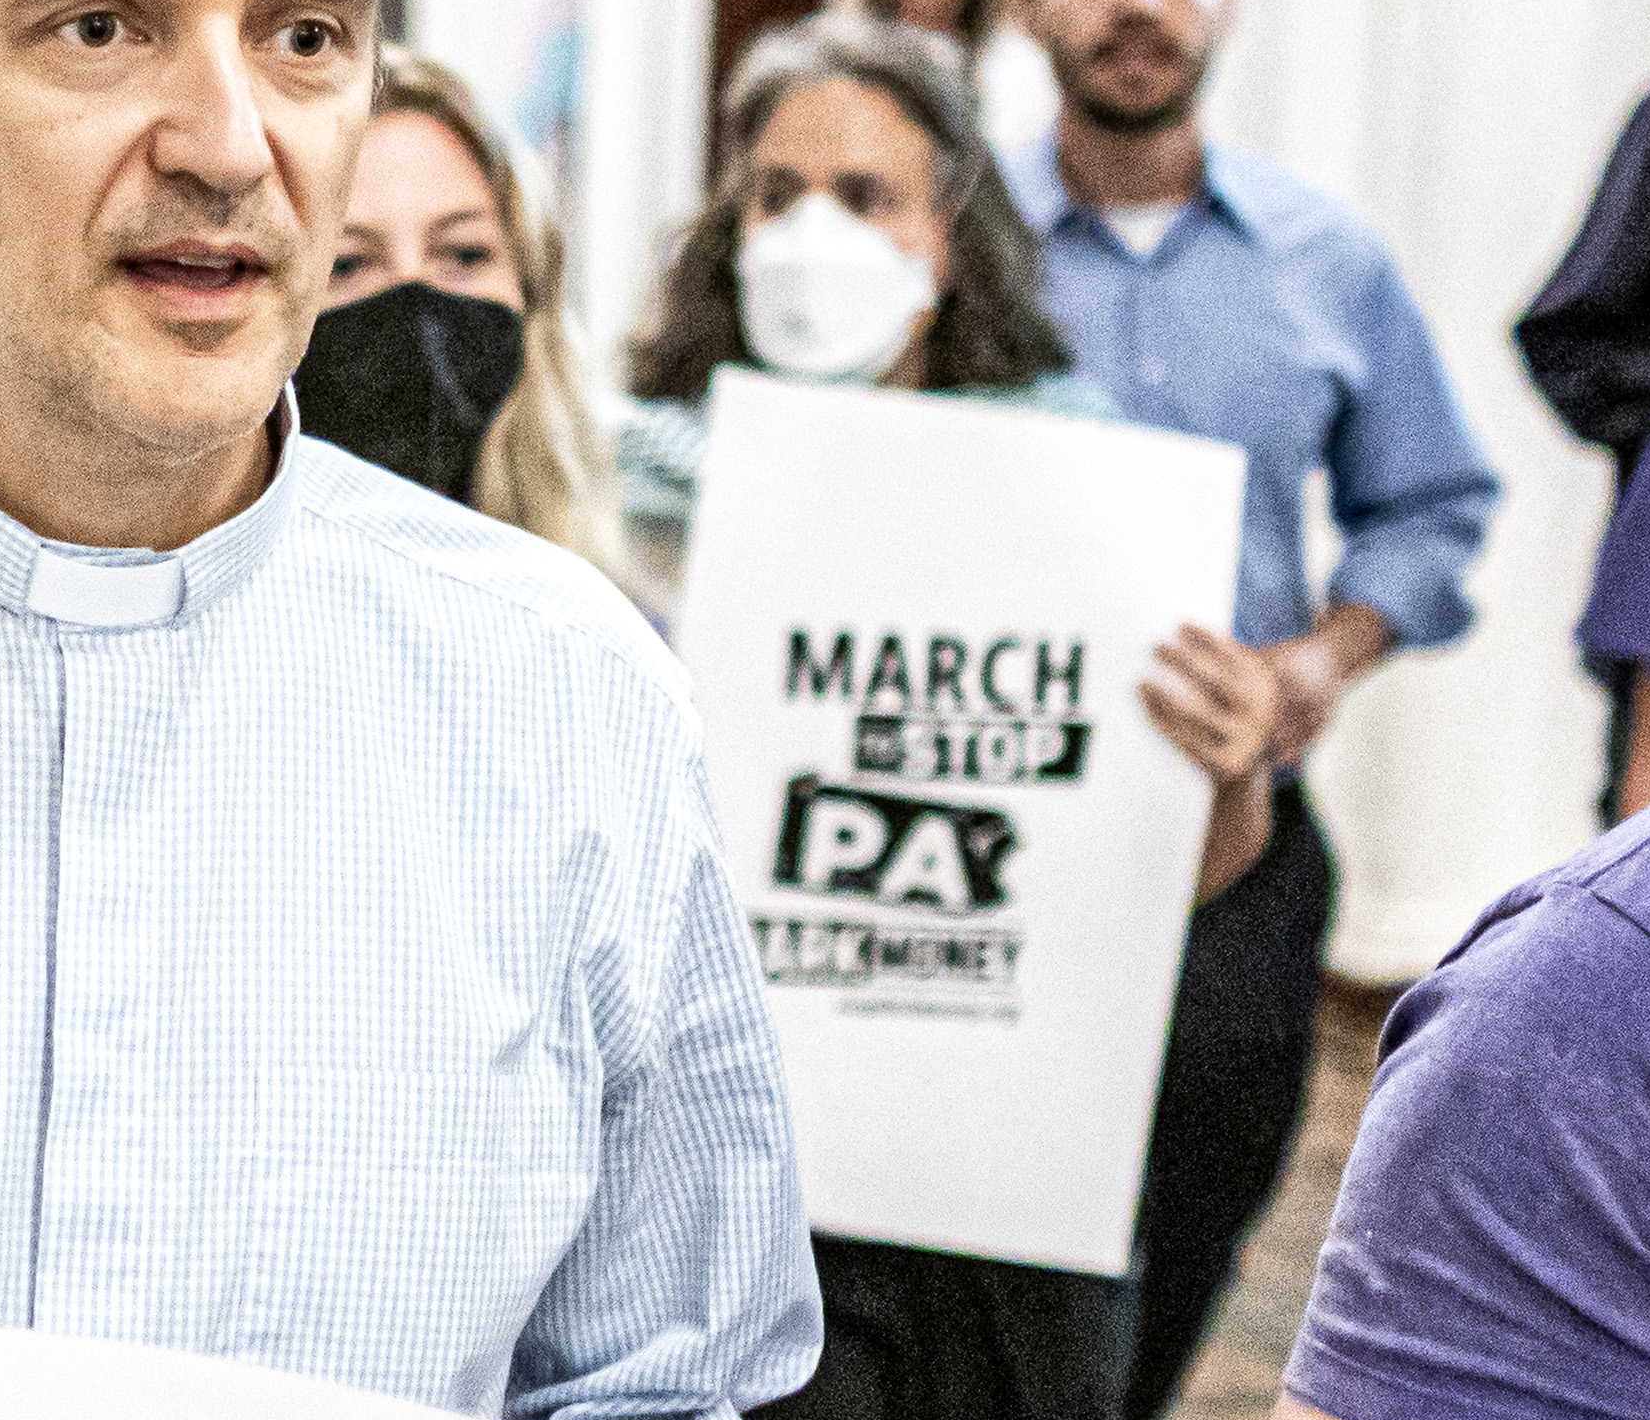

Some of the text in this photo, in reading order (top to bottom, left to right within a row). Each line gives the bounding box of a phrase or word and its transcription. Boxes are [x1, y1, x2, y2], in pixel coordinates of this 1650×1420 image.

[785, 627, 1084, 715] MARCH
[903, 720, 1065, 778] STOP
[802, 794, 972, 913] PA
